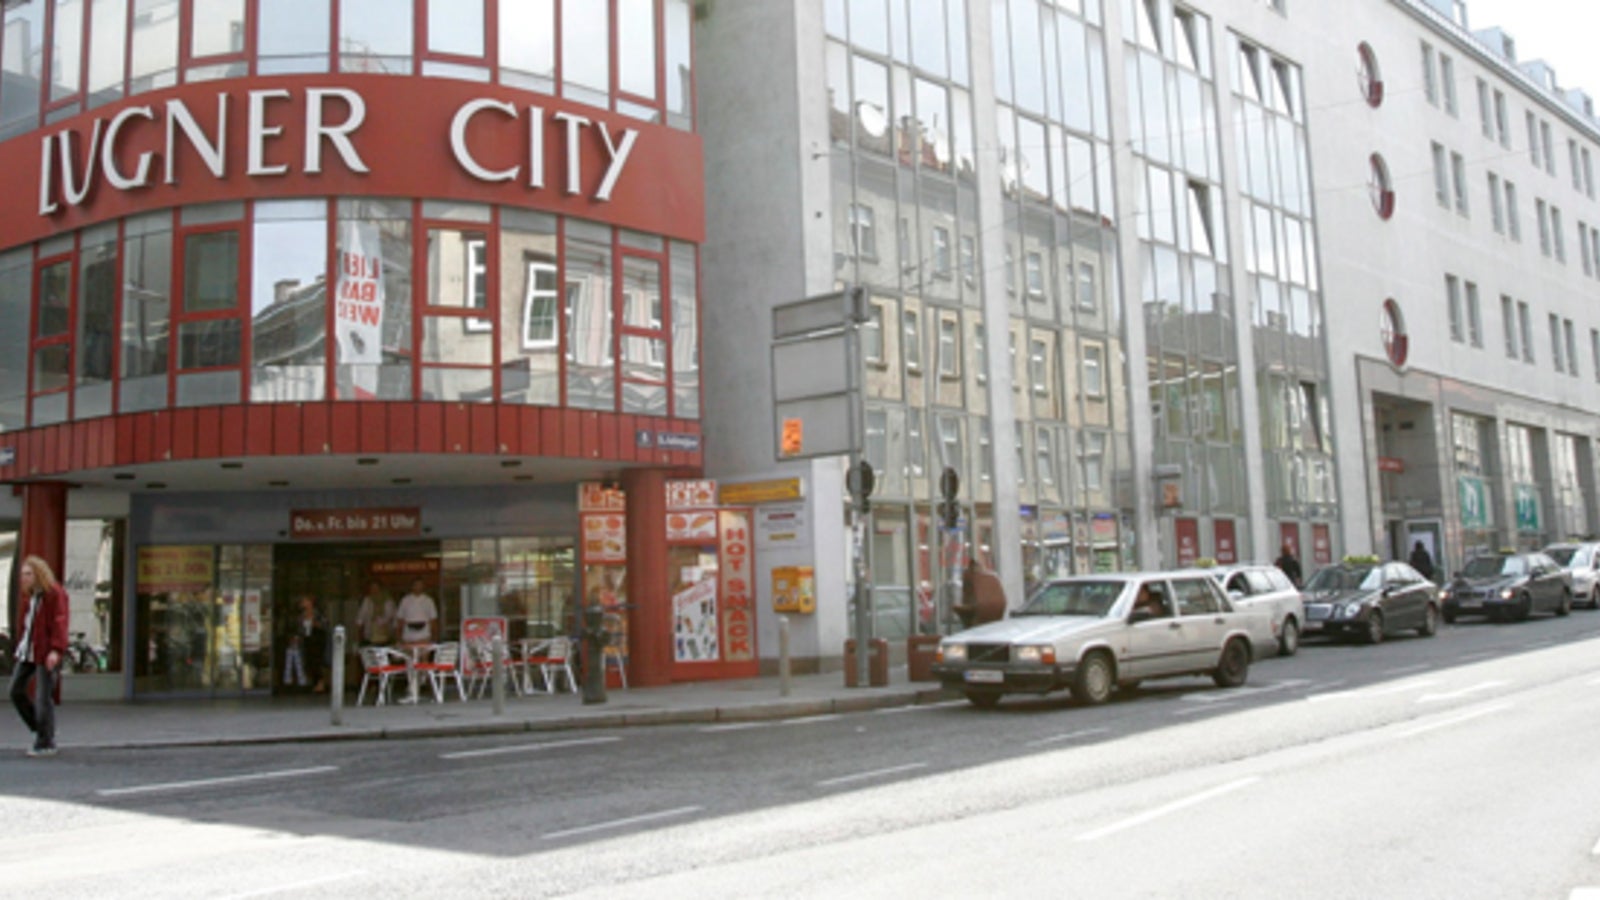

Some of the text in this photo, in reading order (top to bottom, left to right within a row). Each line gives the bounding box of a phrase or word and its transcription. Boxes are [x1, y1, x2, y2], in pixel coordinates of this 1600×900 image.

[39, 86, 639, 216] LUGNER CITY
[346, 514, 368, 529] bis
[372, 515, 388, 529] 21
[390, 513, 416, 529] Uhr
[725, 527, 749, 654] HOT SNACK
